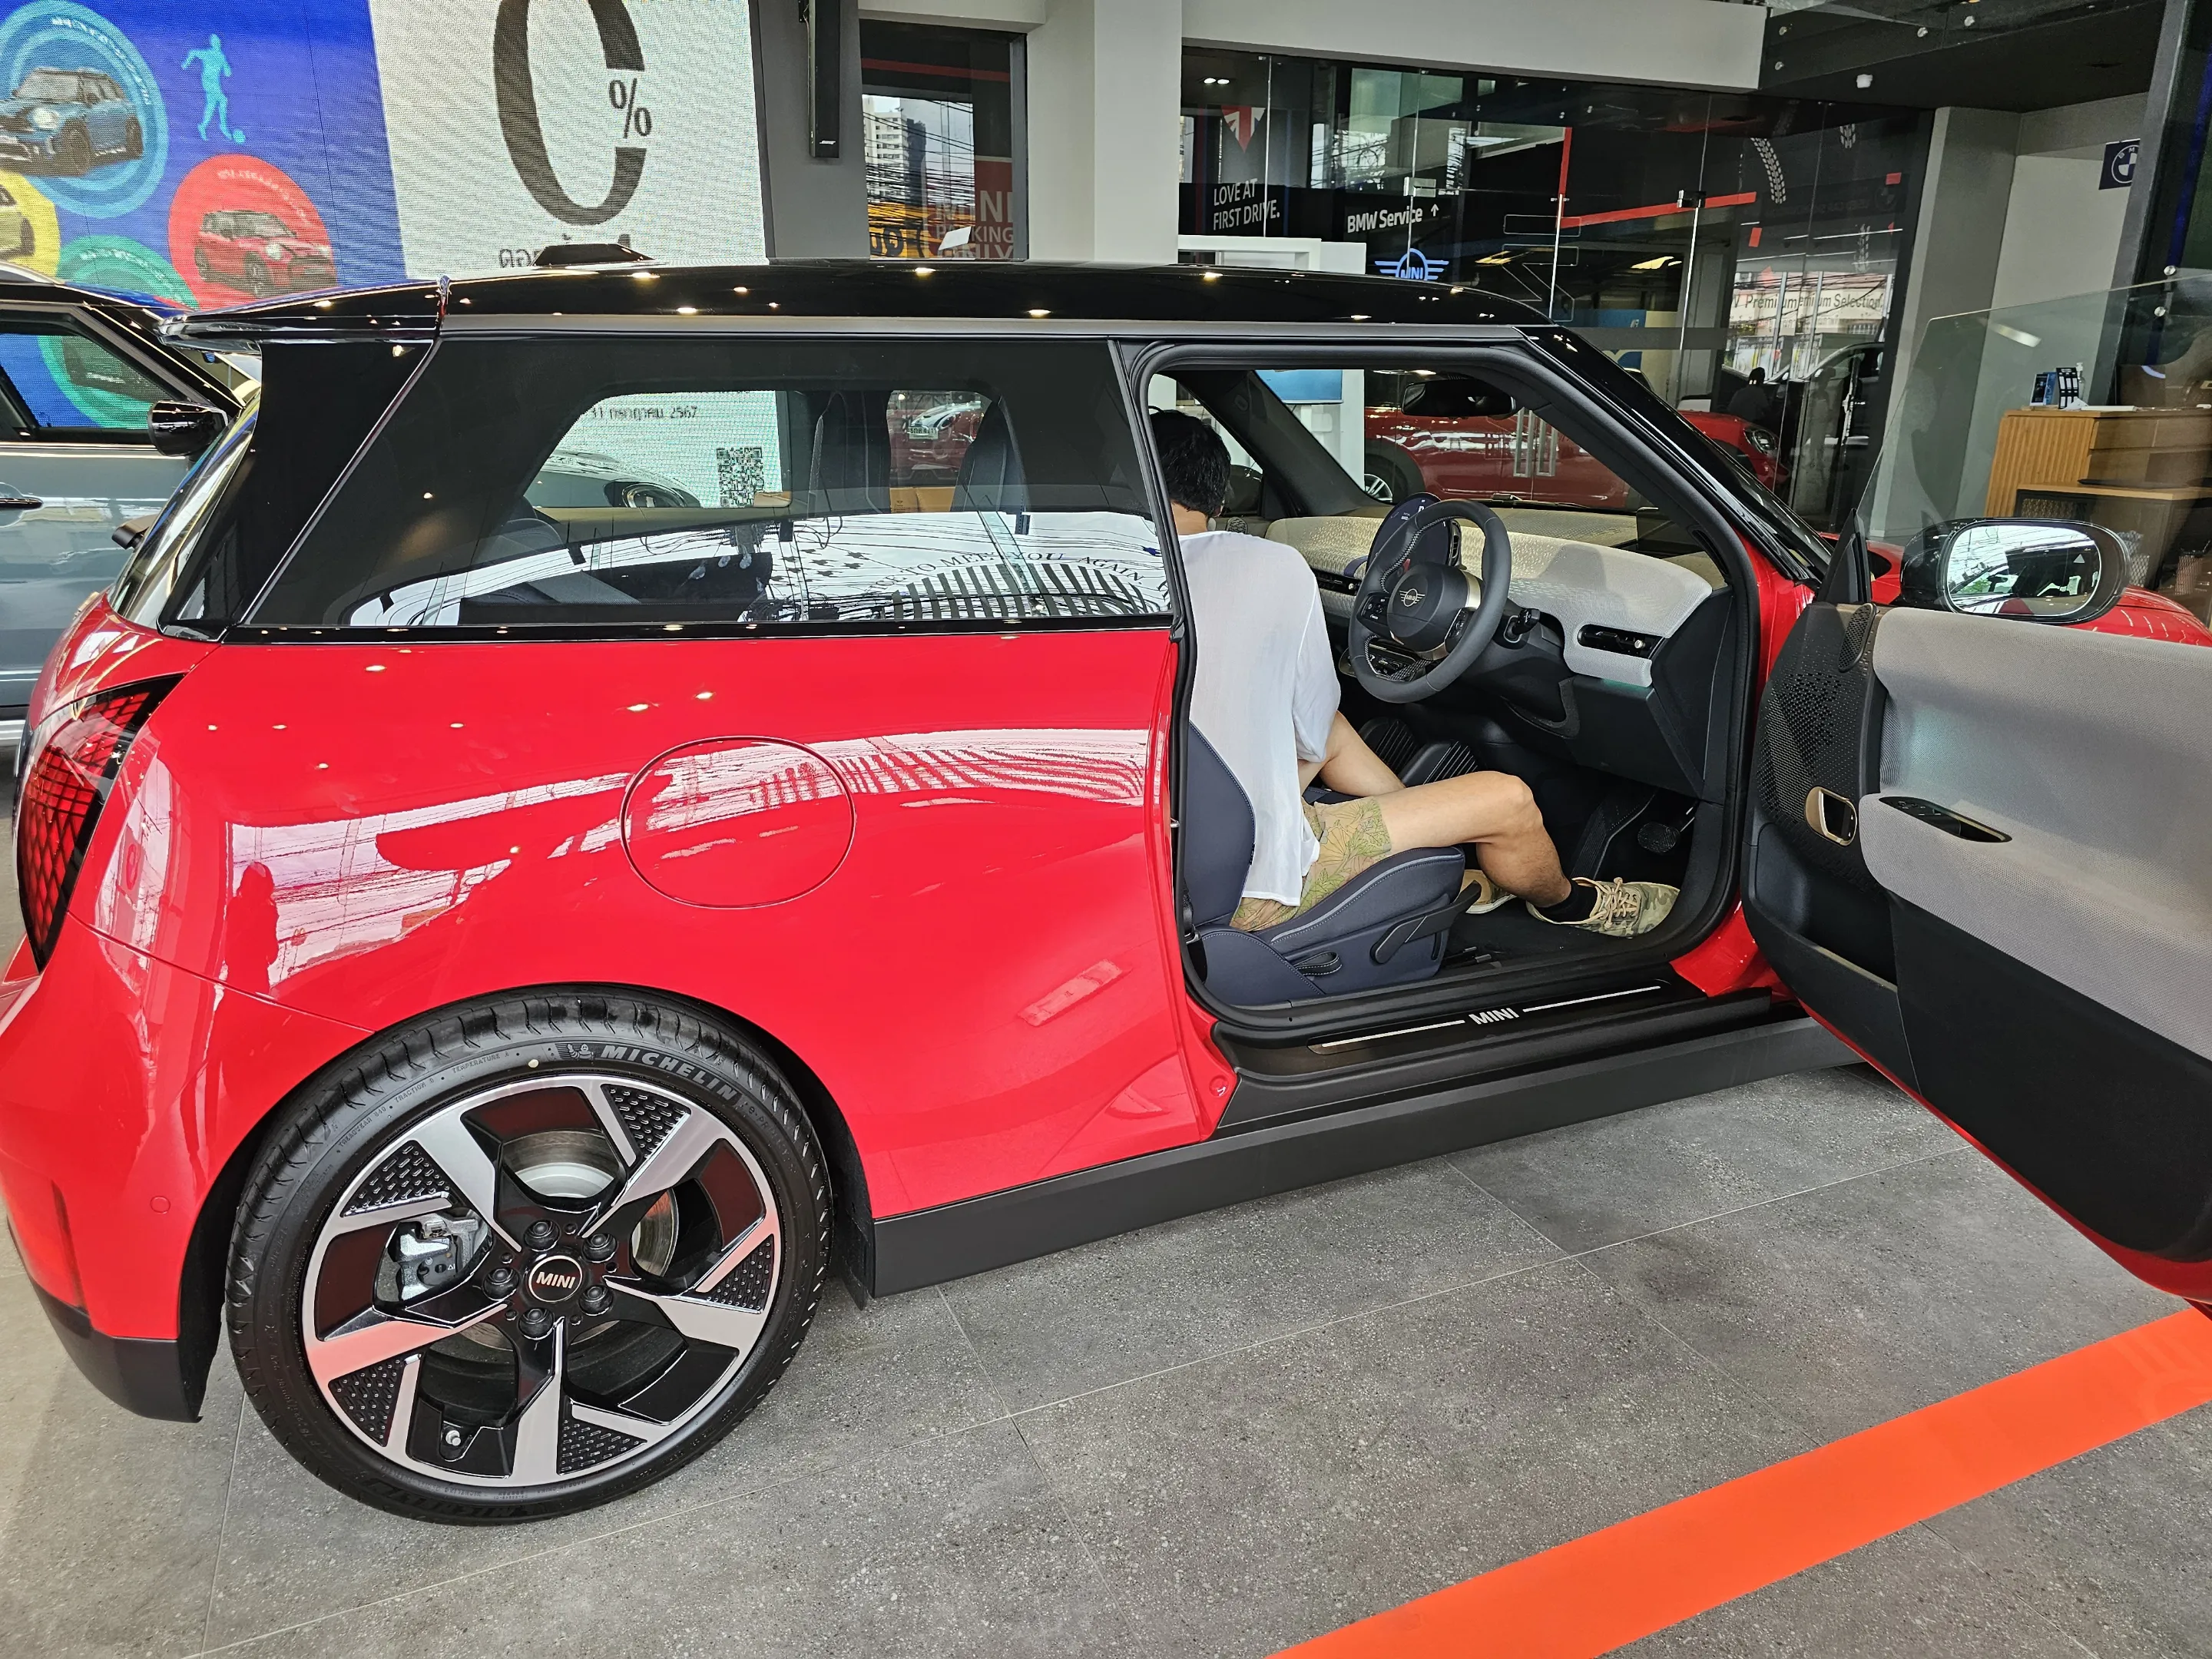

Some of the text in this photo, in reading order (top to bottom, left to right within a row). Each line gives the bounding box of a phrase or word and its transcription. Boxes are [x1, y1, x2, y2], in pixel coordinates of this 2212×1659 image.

[1214, 178, 1257, 206] LOVE AT
[1214, 200, 1280, 230] FIRST DRIVE.
[1348, 205, 1422, 233] BMW Service
[1008, 551, 1065, 561] YOU
[1469, 1008, 1520, 1025] MINI
[601, 1045, 737, 1101] MICHELIN
[536, 1271, 576, 1289] MINI
